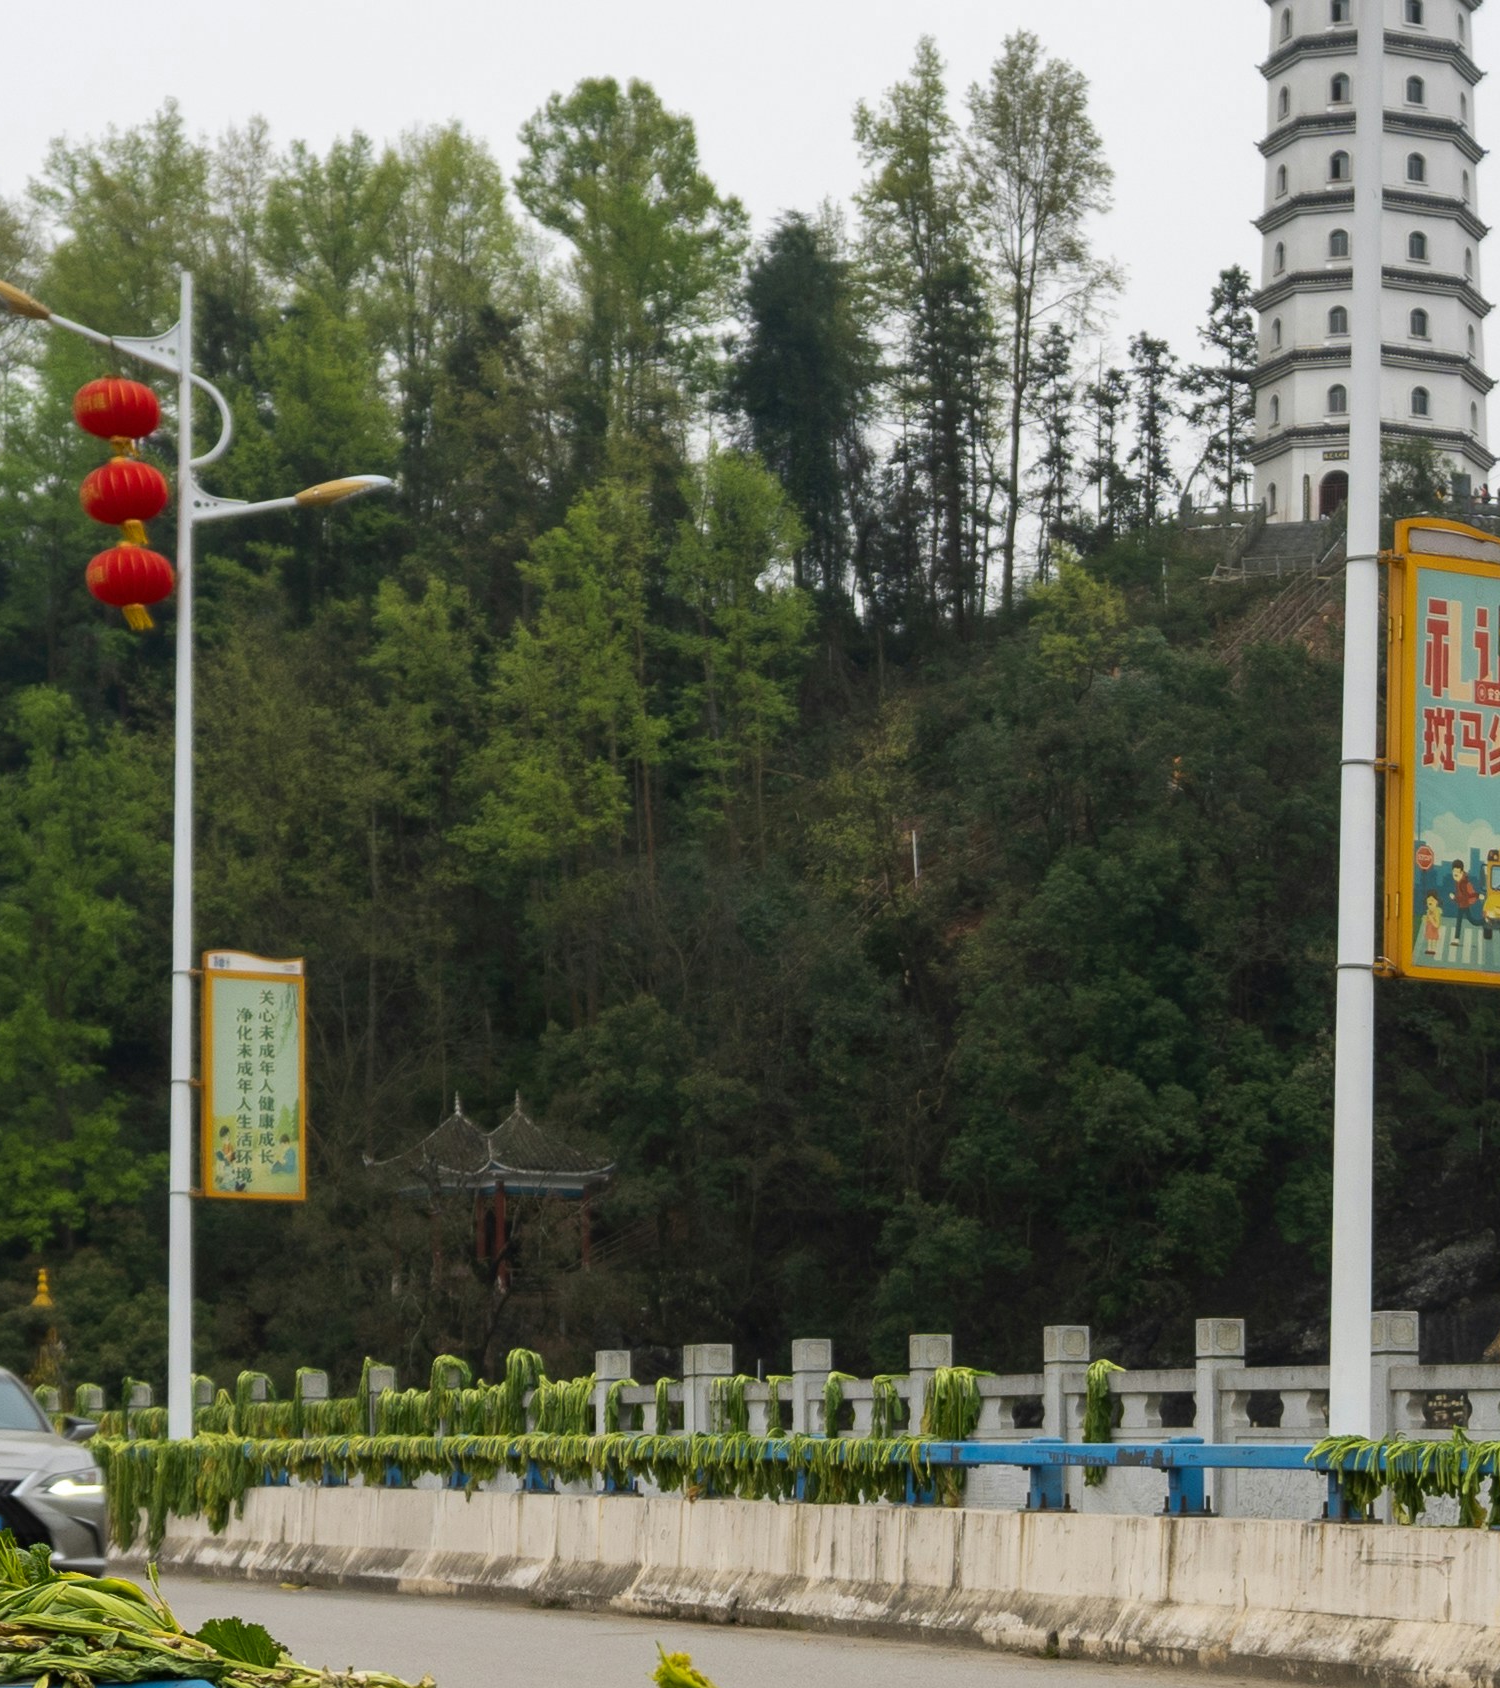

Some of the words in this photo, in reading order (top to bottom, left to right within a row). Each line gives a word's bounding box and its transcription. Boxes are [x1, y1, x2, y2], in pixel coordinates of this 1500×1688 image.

[235, 1007, 254, 1184] 净化未成年人生活环境
[258, 989, 276, 1165] 关心未成年人健康成长
